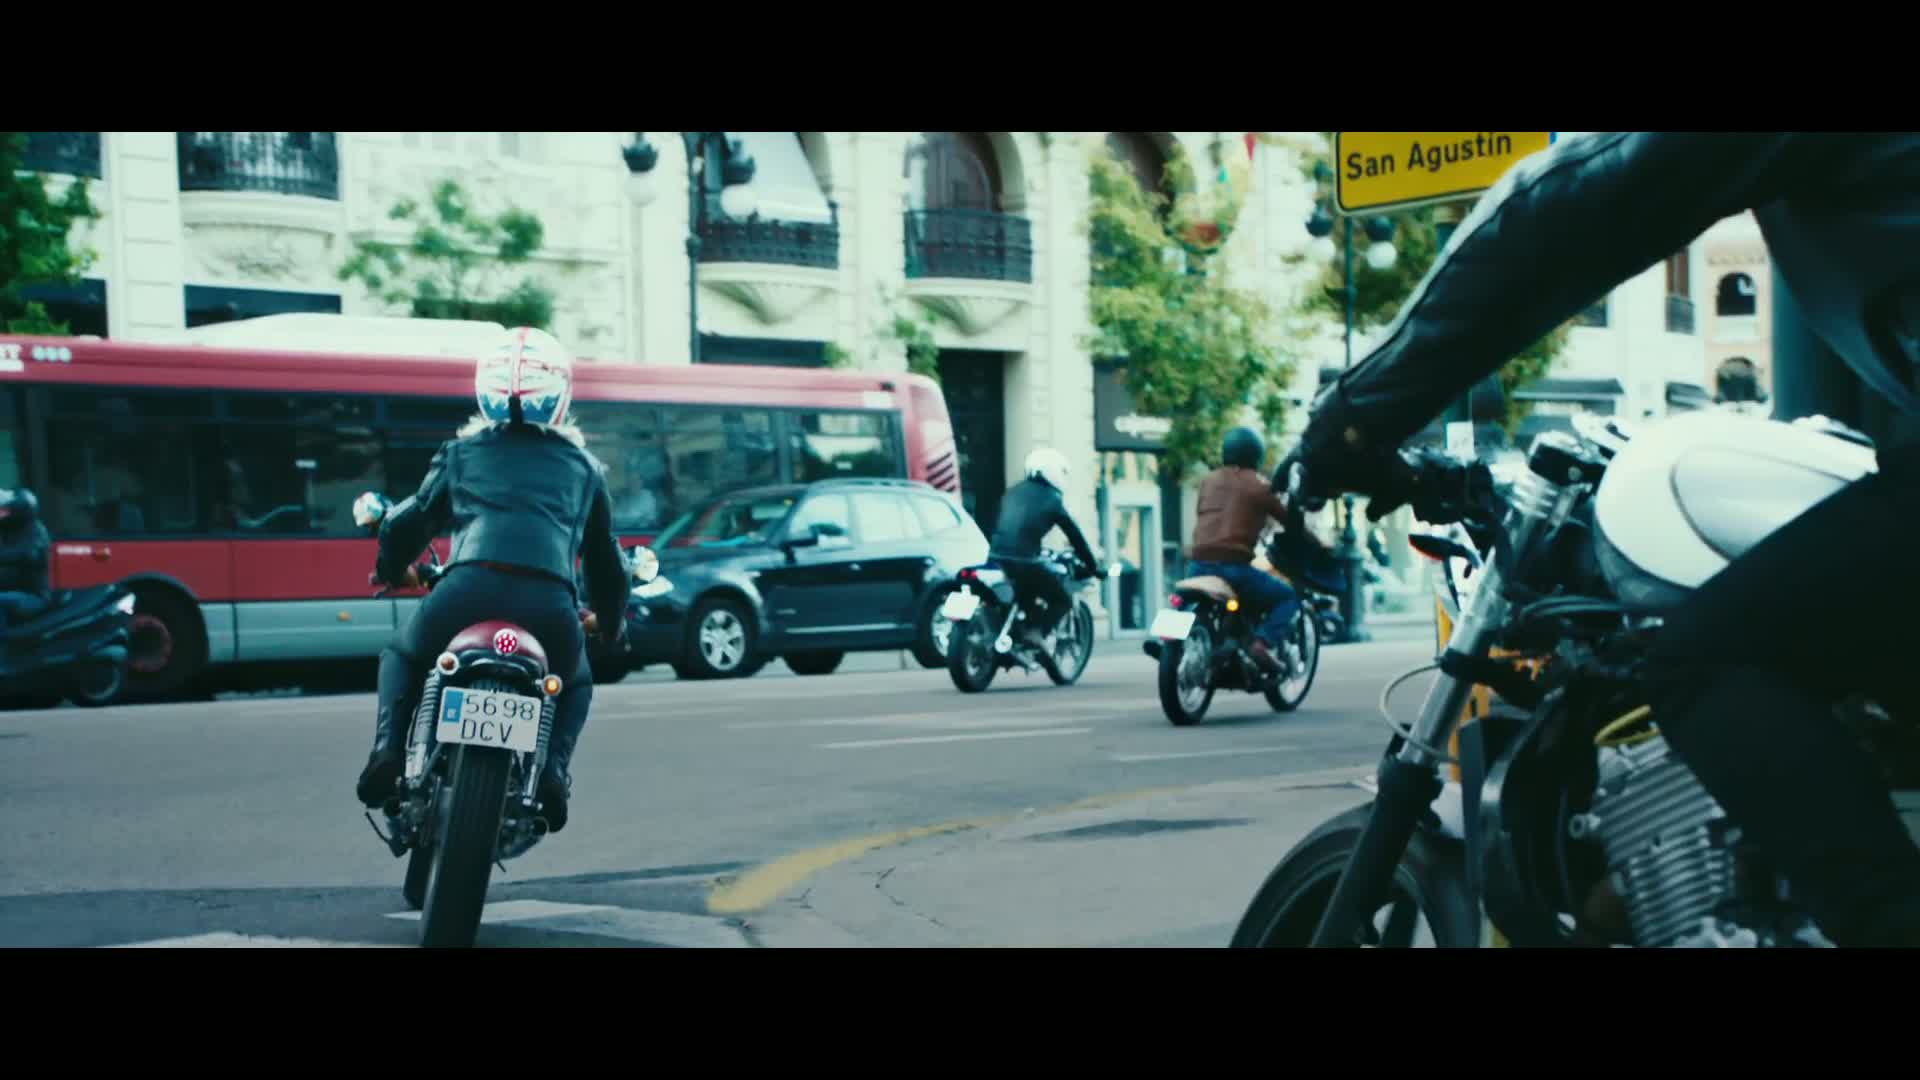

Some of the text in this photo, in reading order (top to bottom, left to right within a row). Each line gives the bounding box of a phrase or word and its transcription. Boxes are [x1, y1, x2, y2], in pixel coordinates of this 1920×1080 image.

[1346, 153, 1395, 180] San
[465, 694, 534, 720] 5698
[461, 719, 513, 743] DCV
